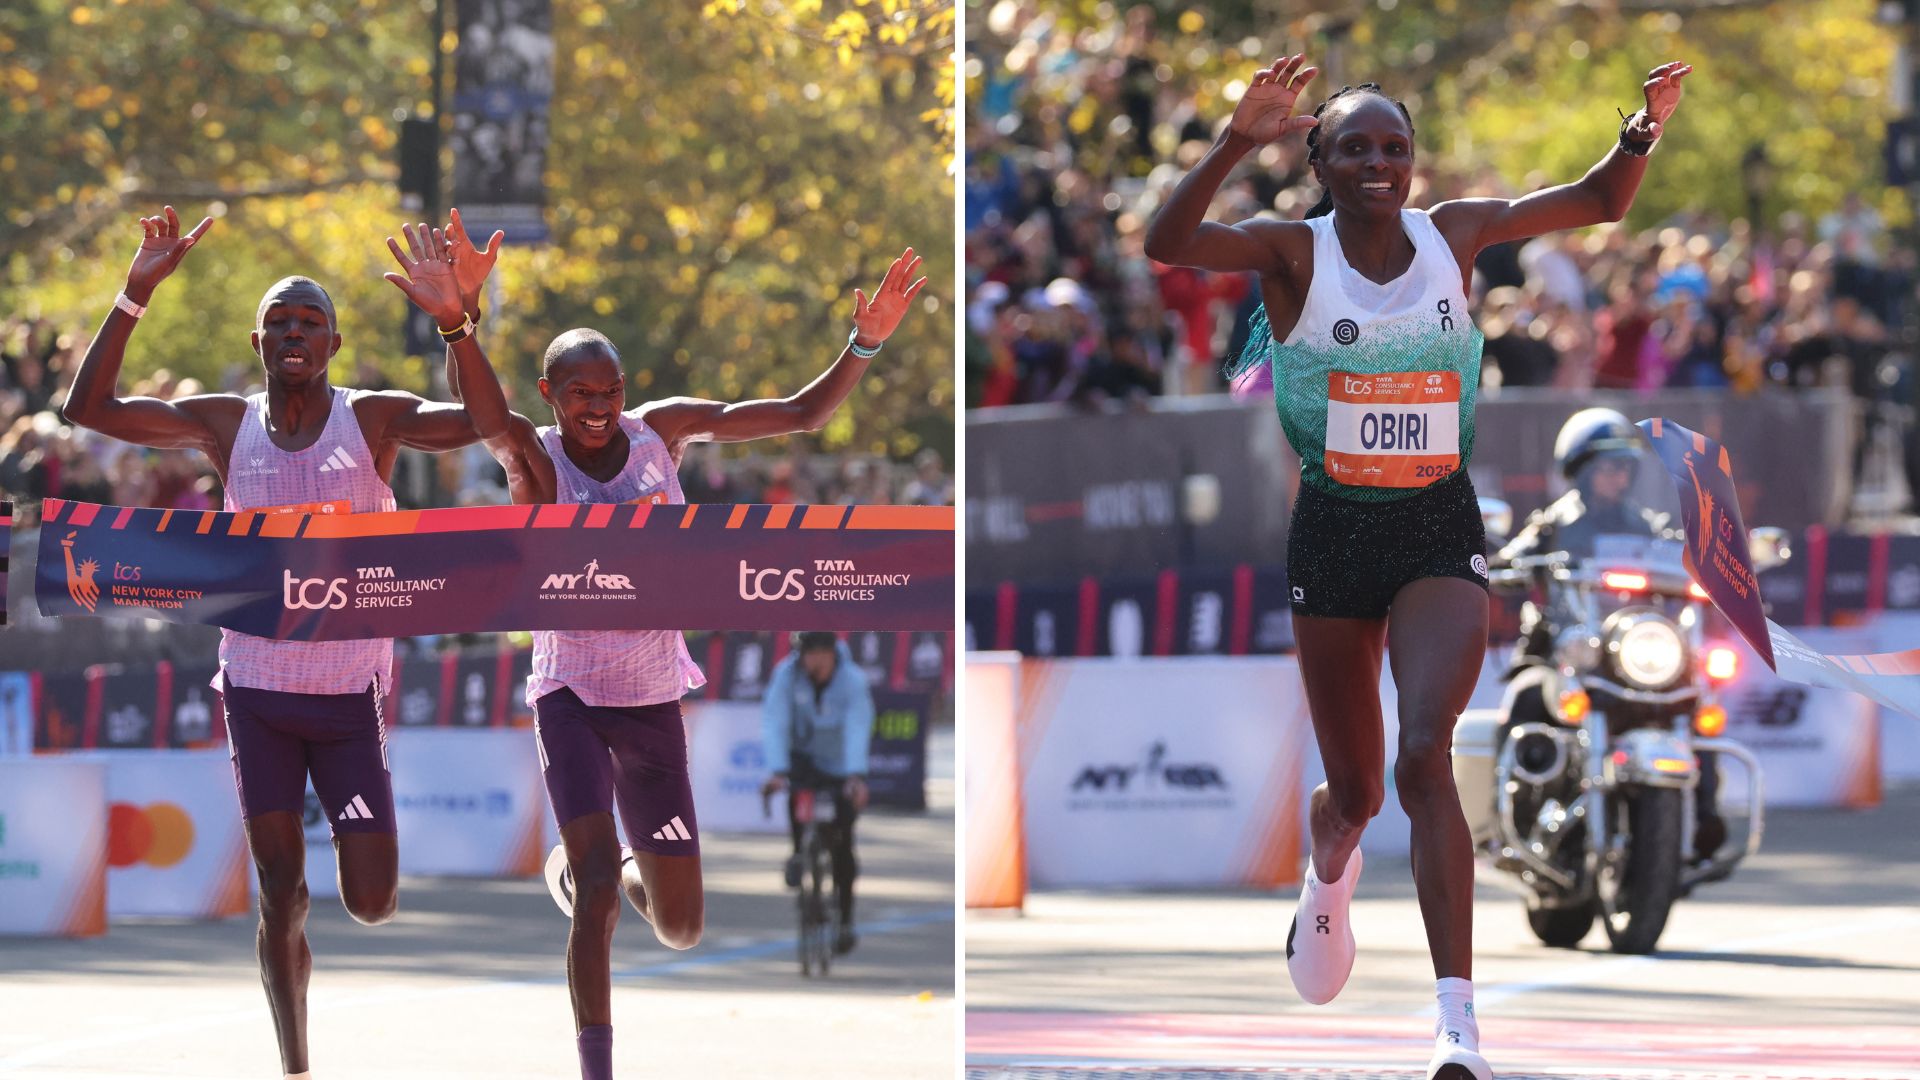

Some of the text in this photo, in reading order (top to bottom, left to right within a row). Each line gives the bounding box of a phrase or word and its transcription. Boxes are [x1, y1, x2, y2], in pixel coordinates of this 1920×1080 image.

[1344, 375, 1373, 395] tcs
[1360, 412, 1428, 450] OBIRI
[1415, 464, 1453, 478] 2025
[814, 559, 856, 571] TATA
[1715, 536, 1729, 560] NEW
[1729, 553, 1748, 580] YORK
[113, 561, 142, 581] tcs
[356, 567, 396, 580] TATA
[1713, 552, 1748, 600] MARATHON
[356, 578, 447, 594] CONSULTANCY
[739, 559, 806, 601] tcs
[813, 574, 911, 587] CONSULTANCY
[112, 585, 203, 600] NEW YORK CITY
[284, 568, 348, 610] tcs
[813, 589, 875, 601] SERVICES
[113, 597, 183, 609] MARATHON
[354, 595, 413, 609] SERVICES
